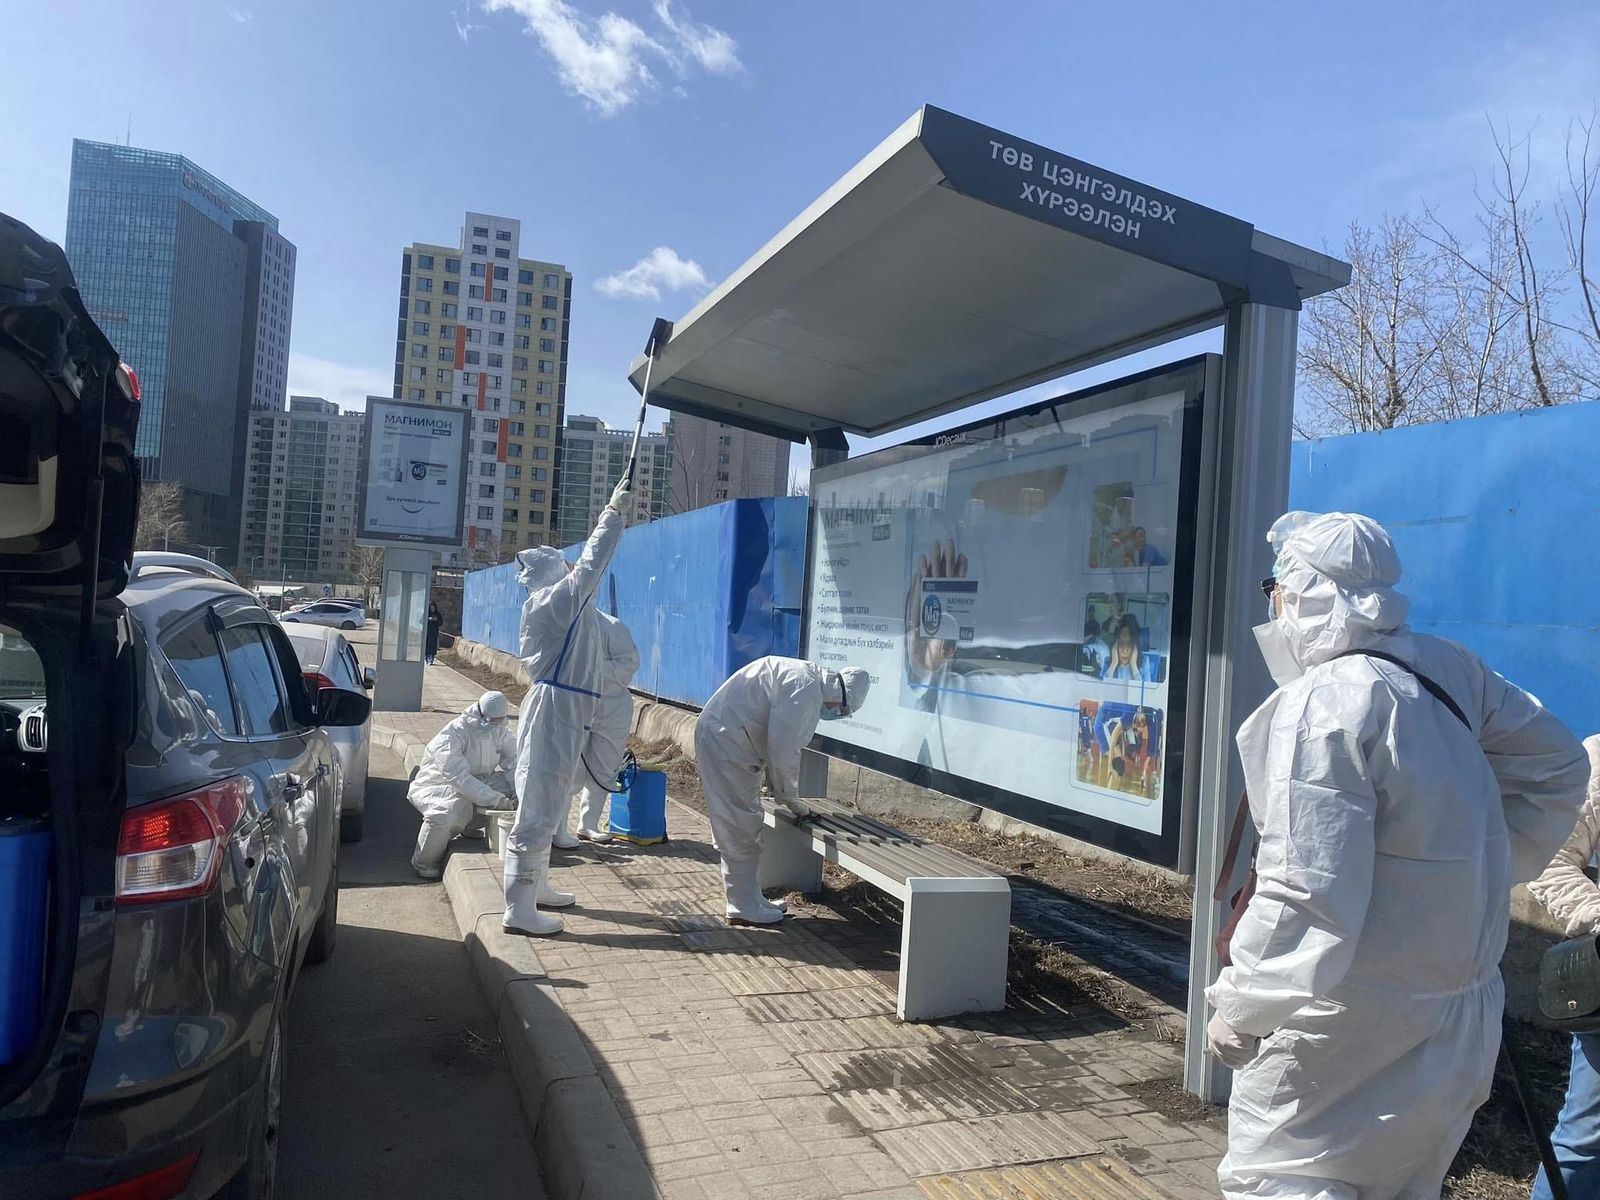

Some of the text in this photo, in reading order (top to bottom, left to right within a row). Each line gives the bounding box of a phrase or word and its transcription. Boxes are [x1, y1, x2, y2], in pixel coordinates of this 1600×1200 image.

[989, 140, 1177, 224] ТӨВ ЦЭНГЭЛДЭХ
[1019, 182, 1141, 239] ХҮРЭЭЛЭН
[384, 414, 452, 430] МАГНИМОН
[924, 605, 938, 626] Mg
